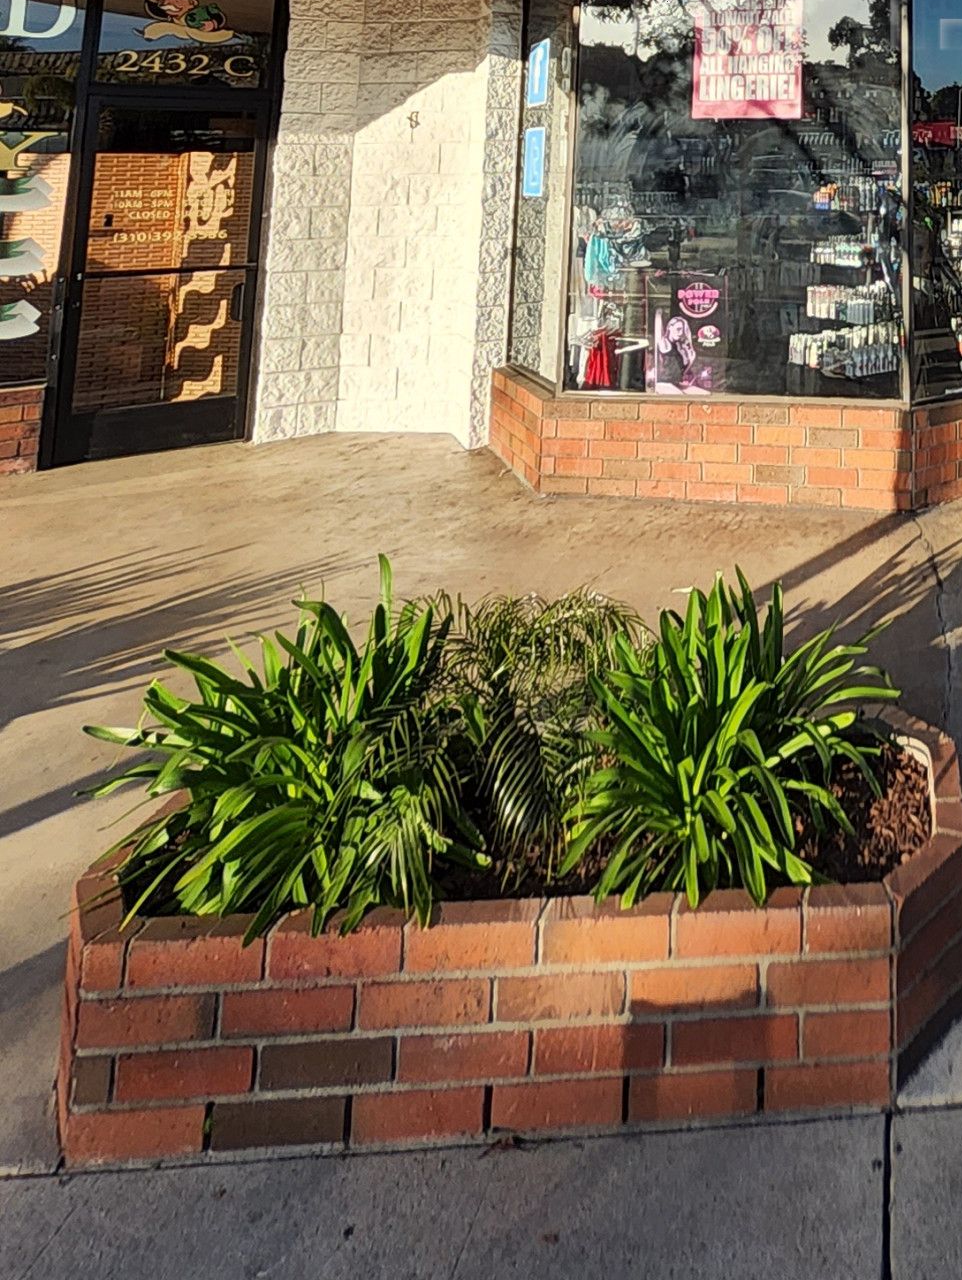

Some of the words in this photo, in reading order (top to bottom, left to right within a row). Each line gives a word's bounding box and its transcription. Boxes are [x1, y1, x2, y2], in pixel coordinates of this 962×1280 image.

[702, 25, 752, 55] 50%
[115, 50, 210, 75] 2432
[223, 56, 255, 77] C
[700, 55, 724, 74] ALL
[728, 54, 796, 75] HANGING
[700, 73, 796, 101] LINGERIE!
